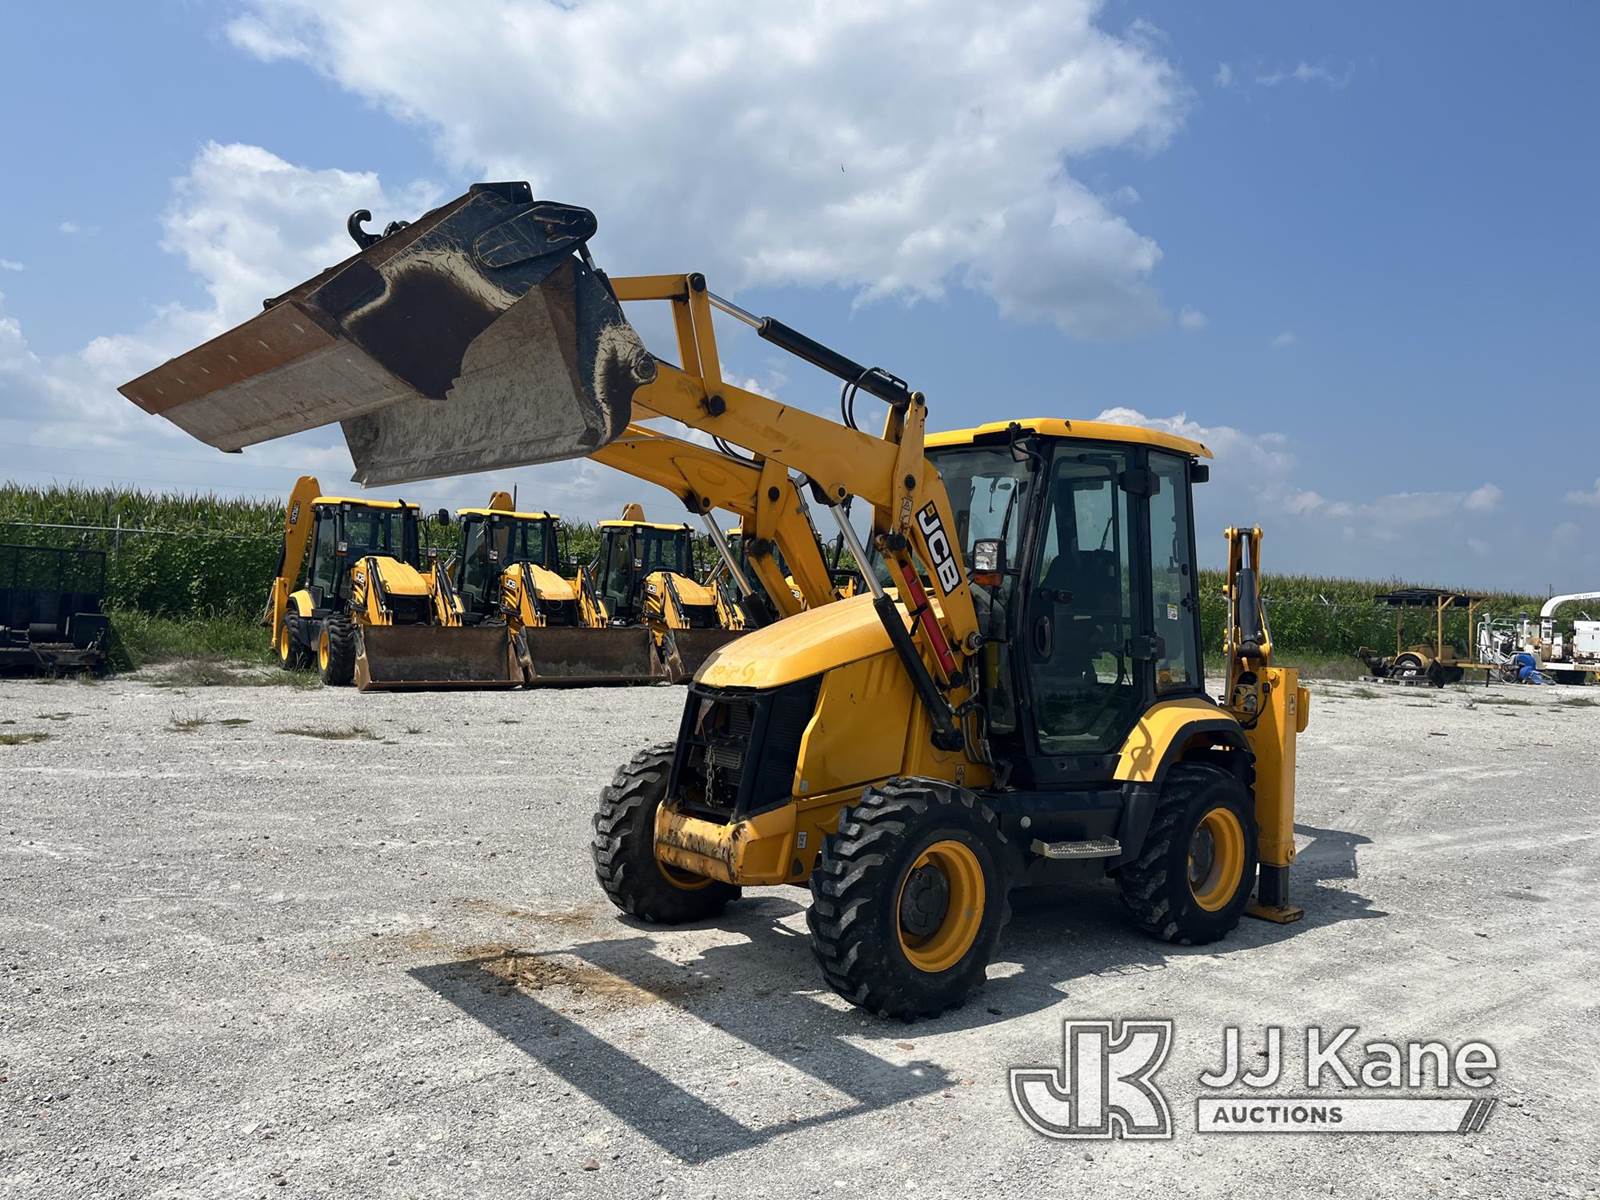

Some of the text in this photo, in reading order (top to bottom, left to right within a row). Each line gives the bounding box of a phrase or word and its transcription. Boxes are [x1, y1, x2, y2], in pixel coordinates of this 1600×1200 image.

[917, 509, 960, 593] JCB
[505, 578, 517, 590] JCB
[646, 583, 658, 594] JCB
